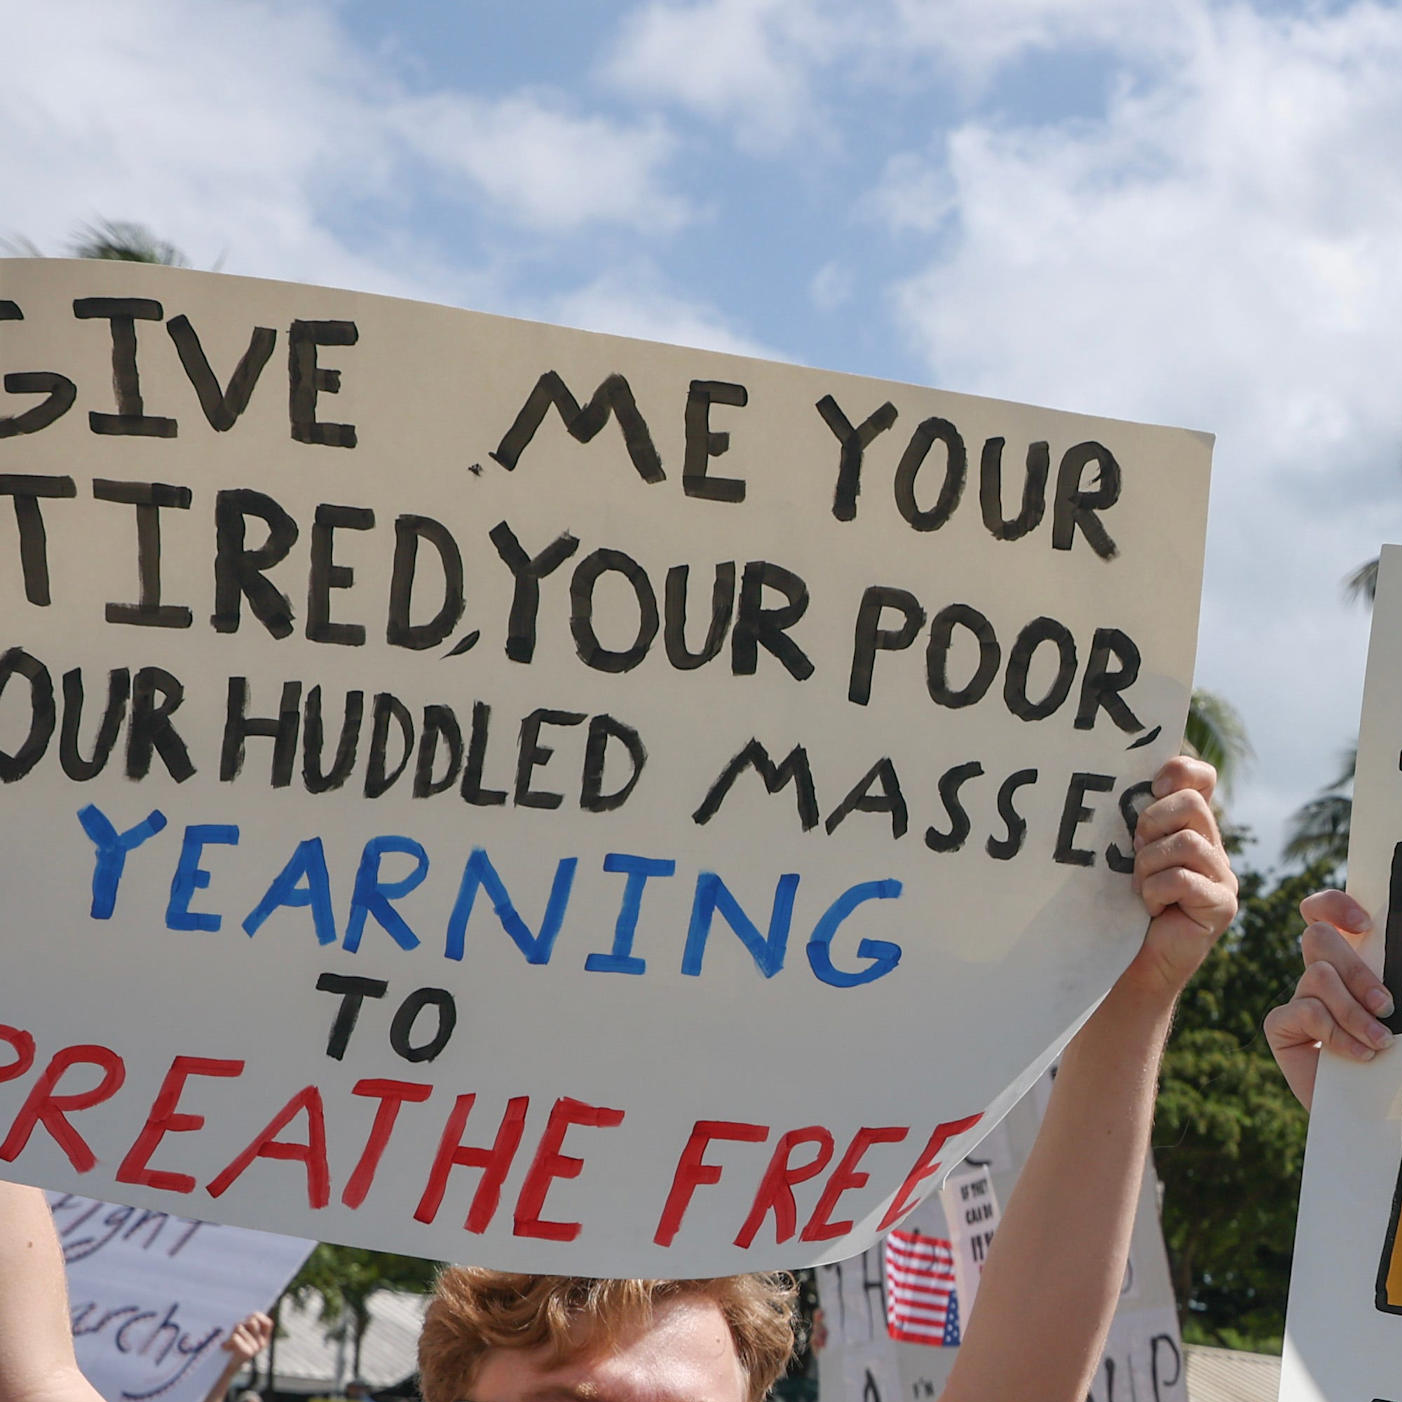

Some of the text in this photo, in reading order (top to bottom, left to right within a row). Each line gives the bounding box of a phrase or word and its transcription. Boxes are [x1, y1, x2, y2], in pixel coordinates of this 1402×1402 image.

[489, 370, 748, 503] ME
[816, 395, 1121, 560] YOUR
[0, 474, 1161, 750] TIRED, YOUR POOR,
[220, 677, 647, 813] HUDDLED
[77, 804, 902, 988] YEARNING
[316, 973, 456, 1063] TO
